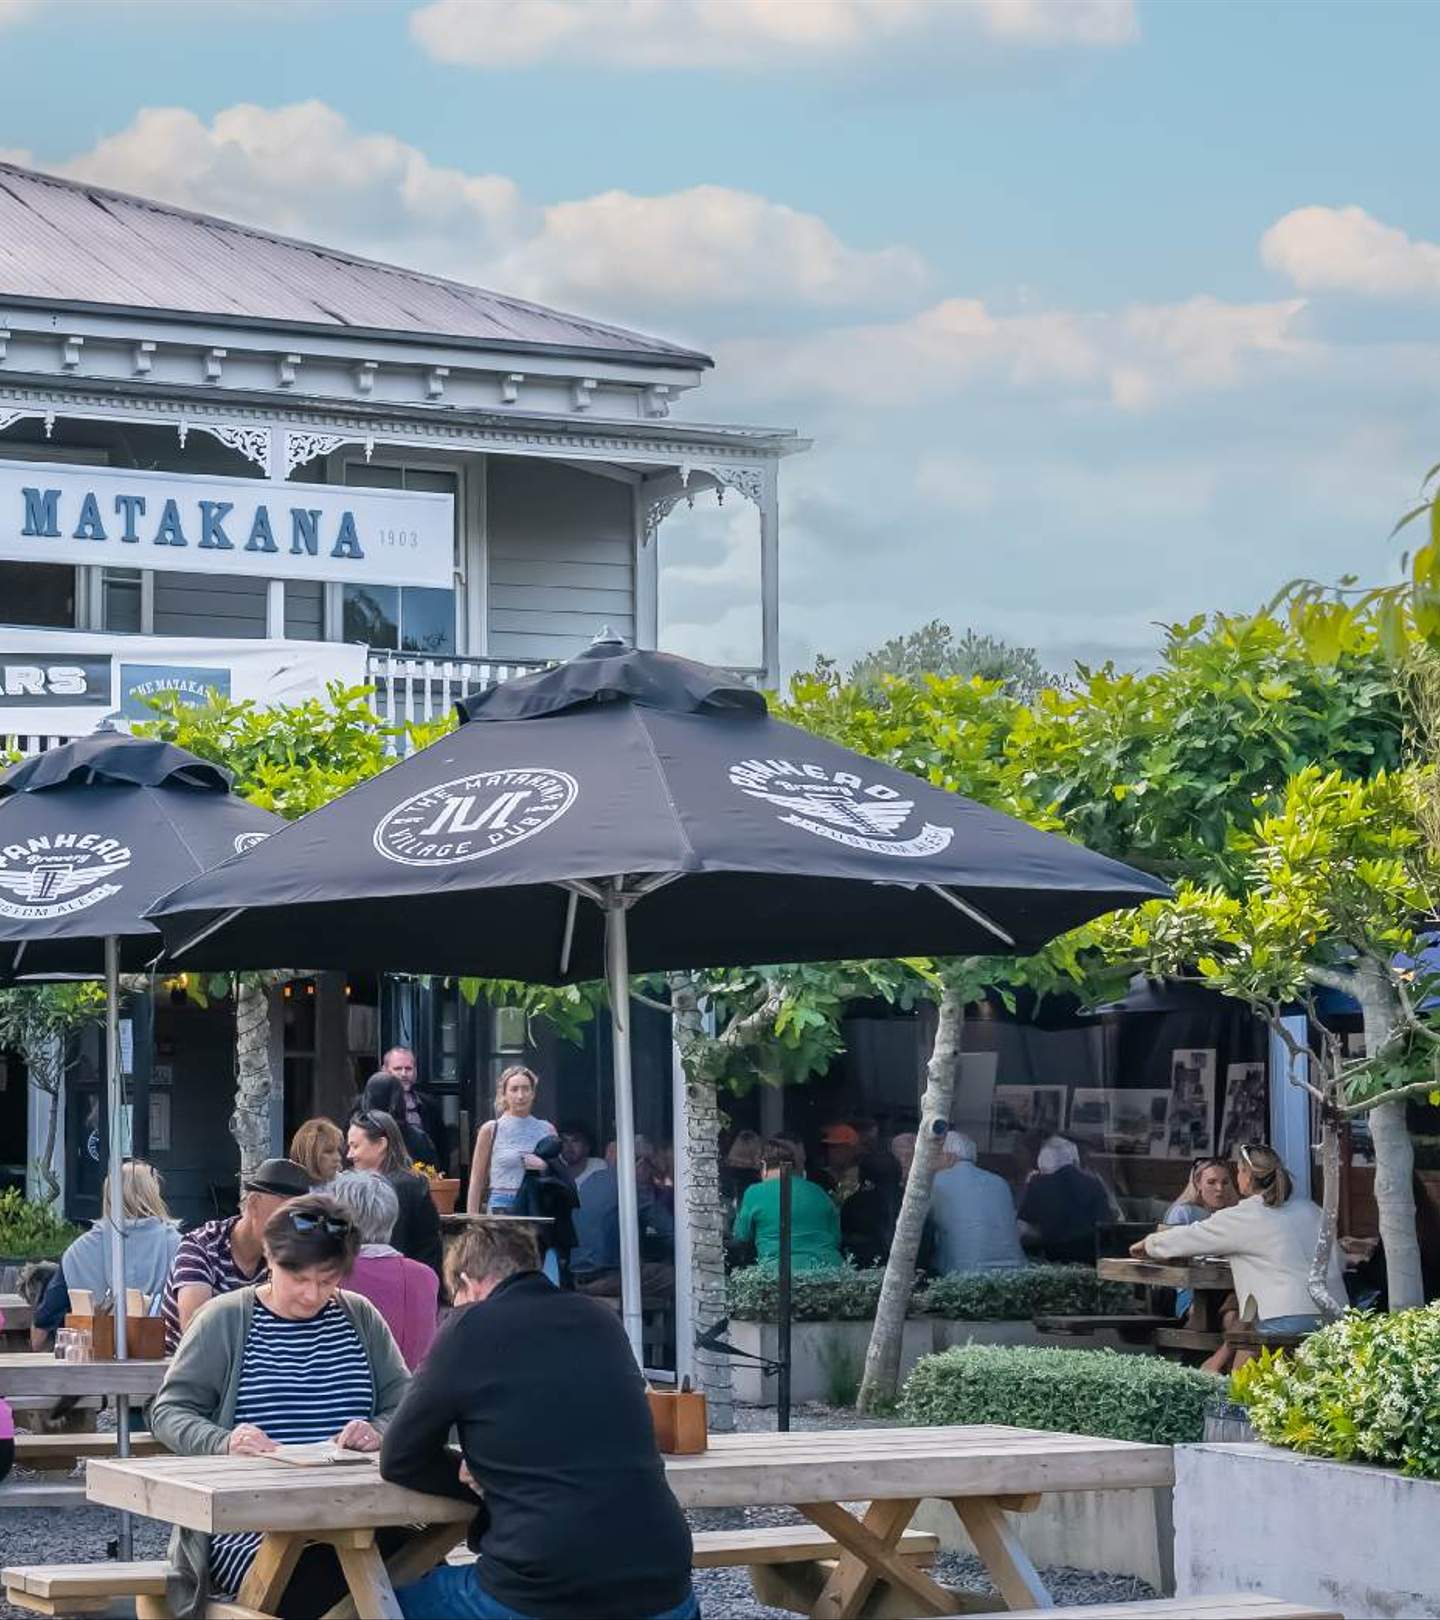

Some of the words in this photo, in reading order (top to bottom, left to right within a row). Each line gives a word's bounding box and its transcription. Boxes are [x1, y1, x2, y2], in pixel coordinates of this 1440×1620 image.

[20, 488, 365, 559] MATAKANA
[378, 528, 419, 548] 1903
[155, 678, 220, 698] MATAKA
[388, 828, 472, 857] VILLAGE
[487, 817, 542, 845] PUB
